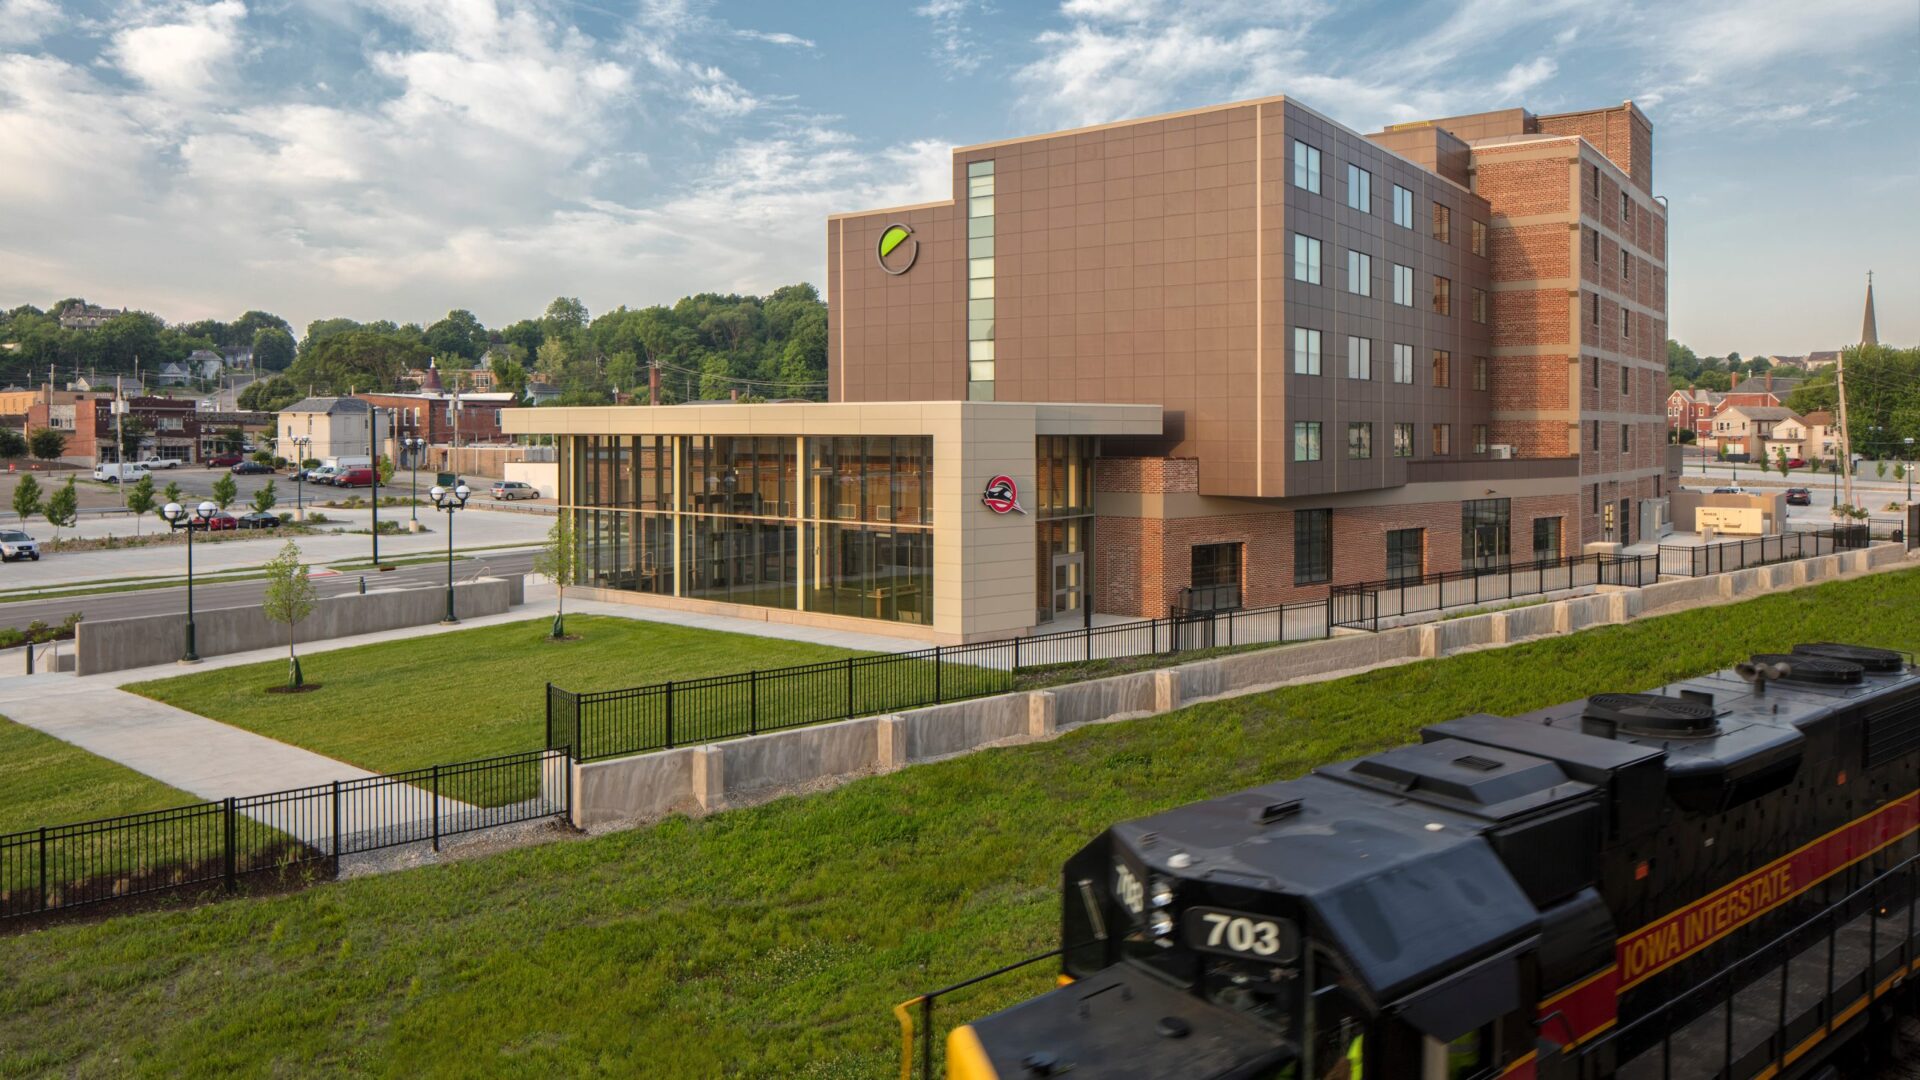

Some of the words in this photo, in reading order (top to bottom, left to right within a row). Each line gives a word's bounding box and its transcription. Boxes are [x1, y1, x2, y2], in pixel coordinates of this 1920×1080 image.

[1203, 913, 1280, 955] 703
[1622, 921, 1681, 980] IOWA
[1683, 863, 1792, 949] INTERSTATE
